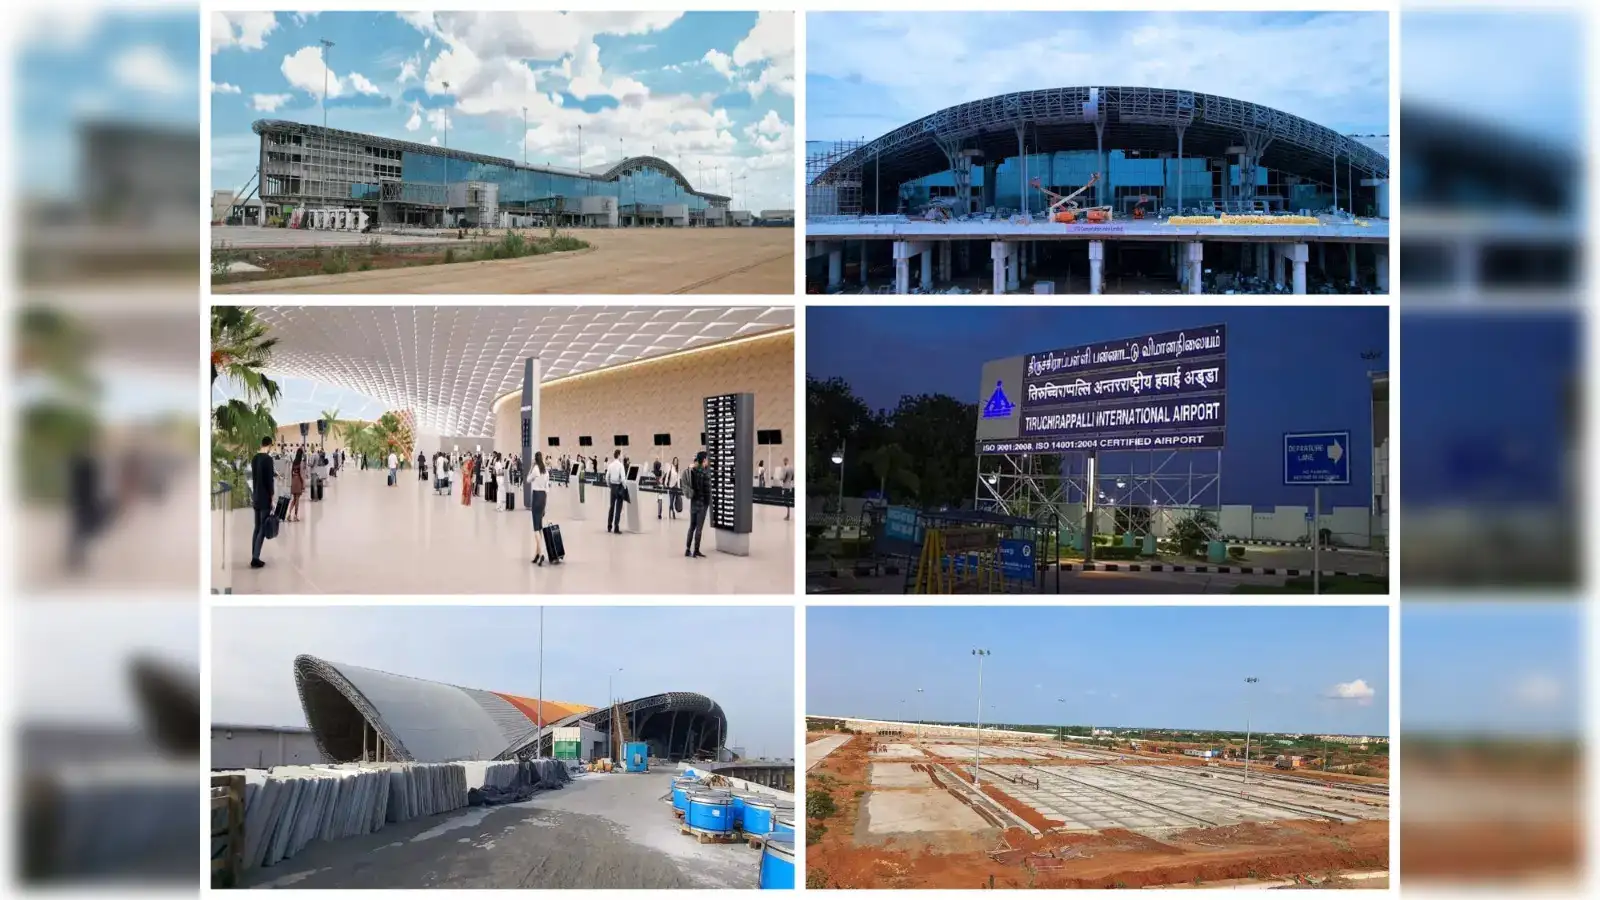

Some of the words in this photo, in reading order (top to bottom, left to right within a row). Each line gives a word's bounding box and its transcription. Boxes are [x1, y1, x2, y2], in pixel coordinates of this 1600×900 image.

[1027, 346, 1091, 377] திருச்சிராப்பள்ளி
[1093, 342, 1139, 363] பன்னாட்டு
[1142, 329, 1220, 358] விமானநிலையம்
[1155, 366, 1181, 389] हवाई
[1184, 367, 1219, 388] अड्डा
[1025, 412, 1095, 431] TIRUCHIRAPPALLI
[1096, 406, 1170, 427] INTERNATIONAL
[1172, 402, 1220, 422] AIRPORT
[1036, 442, 1049, 450] ISO
[1052, 440, 1097, 449] 14001:2004
[1099, 437, 1152, 447] CERTIFIED
[1154, 435, 1204, 445] AIRPORT
